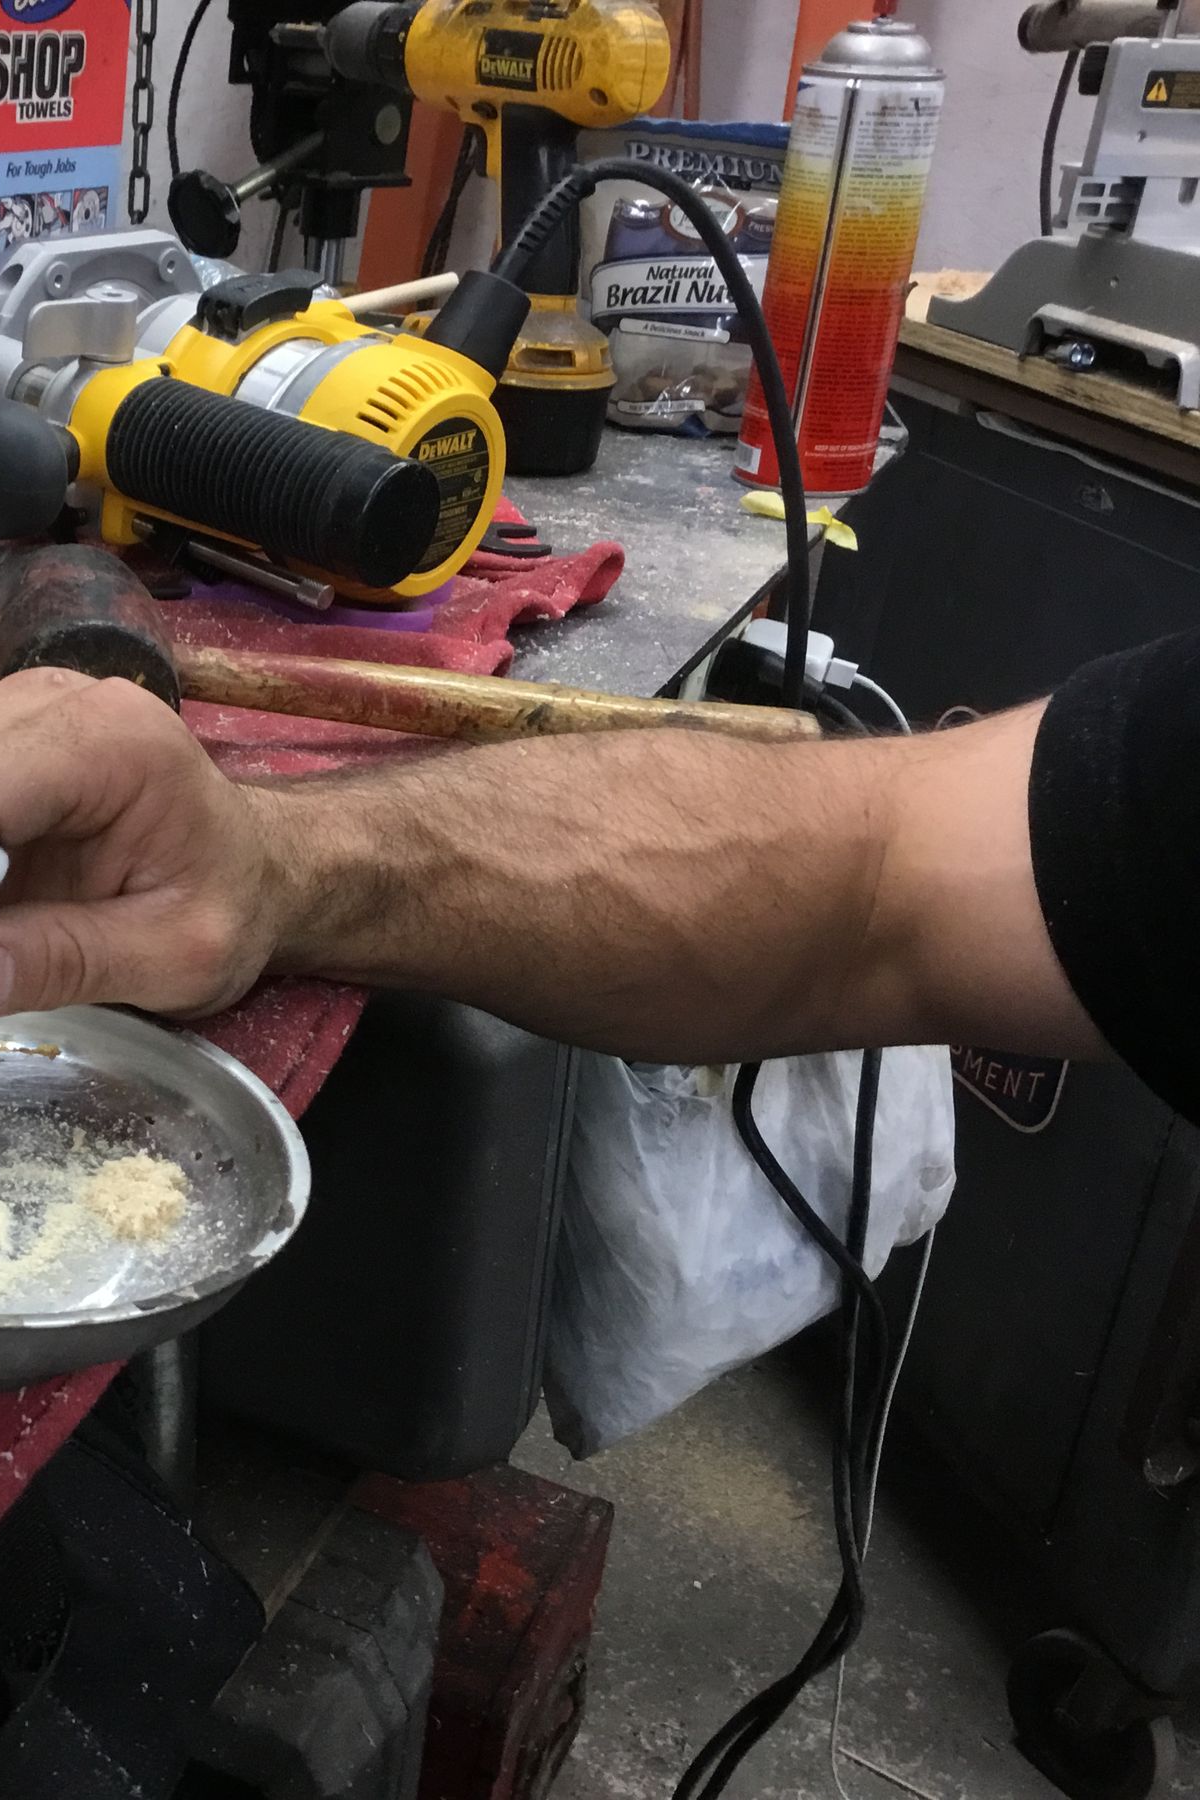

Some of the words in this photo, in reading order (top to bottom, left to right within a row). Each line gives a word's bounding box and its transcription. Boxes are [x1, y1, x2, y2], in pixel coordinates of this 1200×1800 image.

[18, 100, 73, 120] TOWELS
[6, 161, 23, 178] For
[24, 159, 53, 179] Tough
[54, 157, 78, 174] Jobs
[646, 264, 715, 282] Natural
[606, 278, 681, 308] Brazil
[685, 280, 754, 303] Nut
[951, 1045, 1046, 1103] MENT
